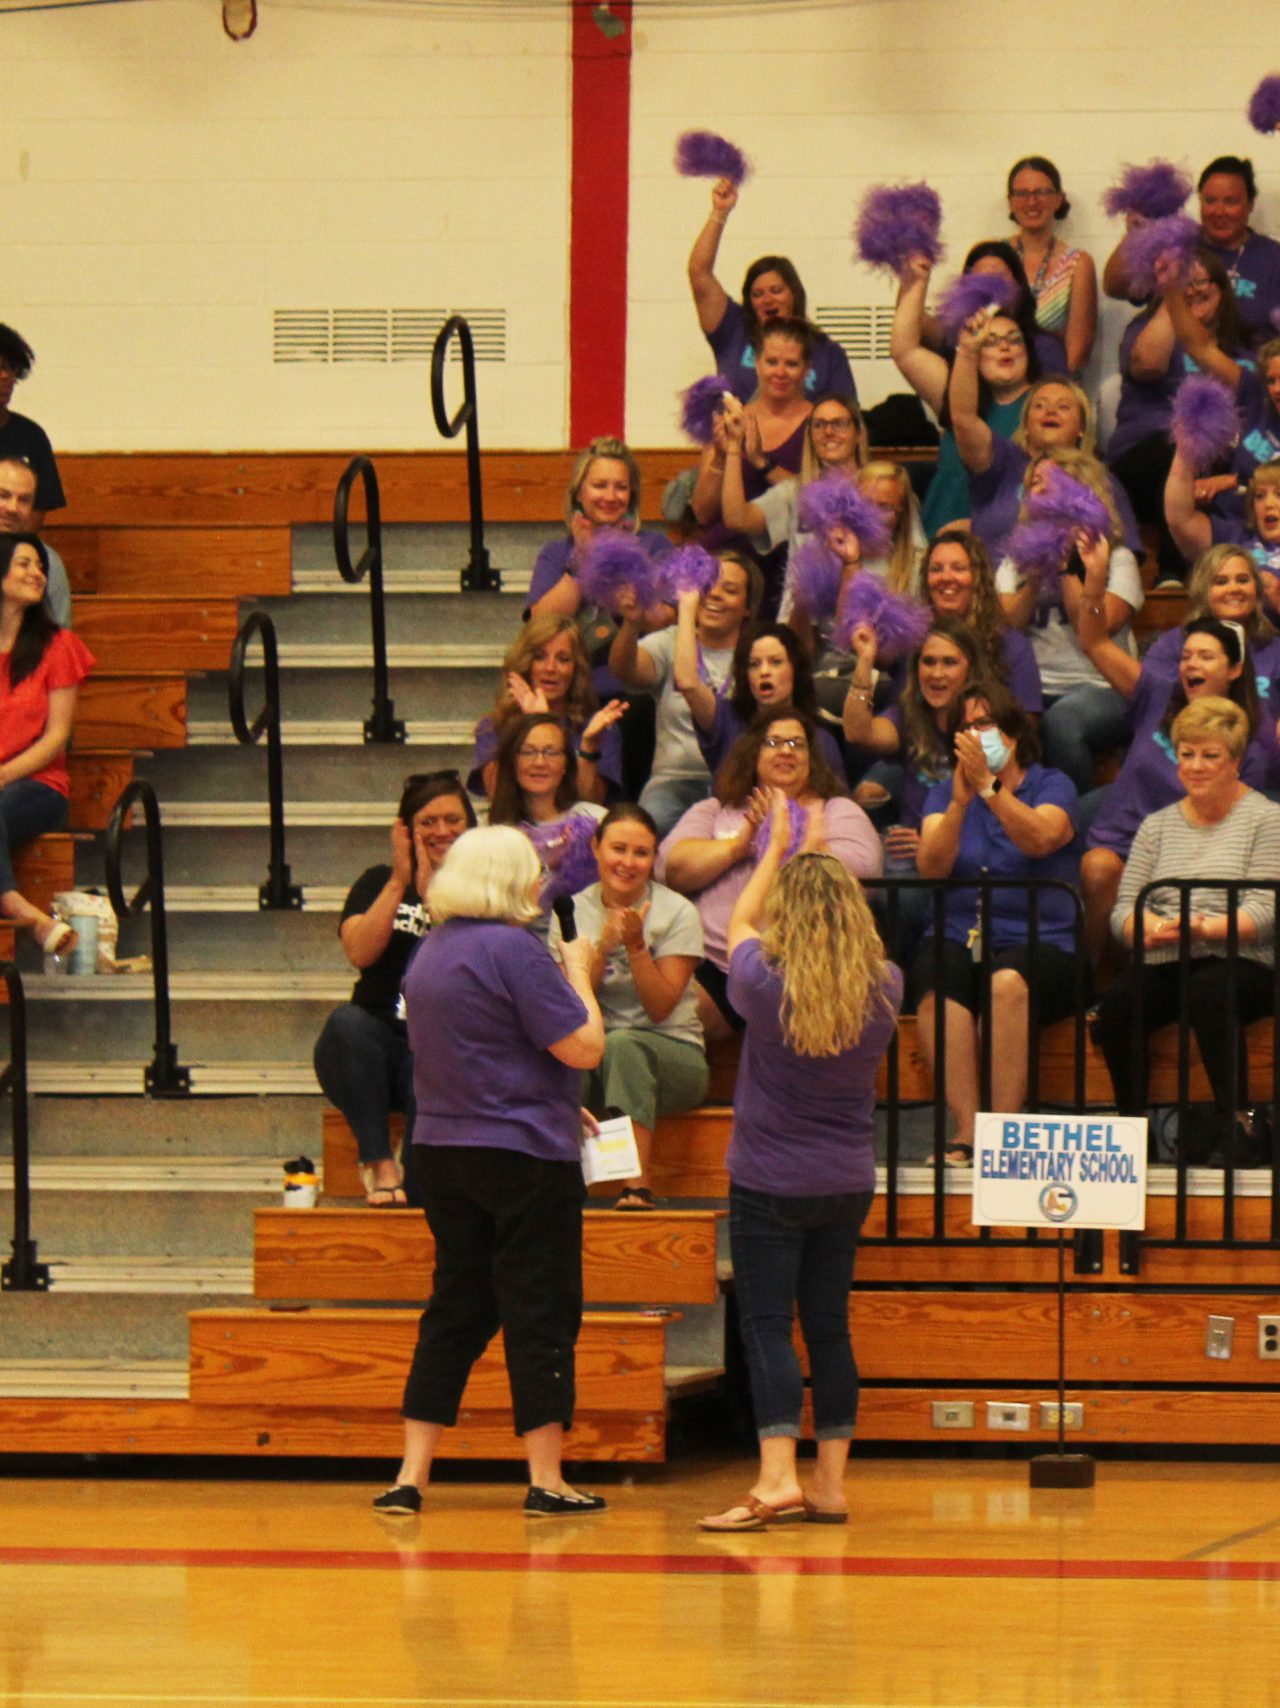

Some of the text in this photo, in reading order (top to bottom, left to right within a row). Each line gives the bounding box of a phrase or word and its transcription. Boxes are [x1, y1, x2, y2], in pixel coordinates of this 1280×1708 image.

[1002, 1121, 1121, 1152] BETHEL
[981, 1149, 1138, 1184] ELEMENTARY SCHOOL
